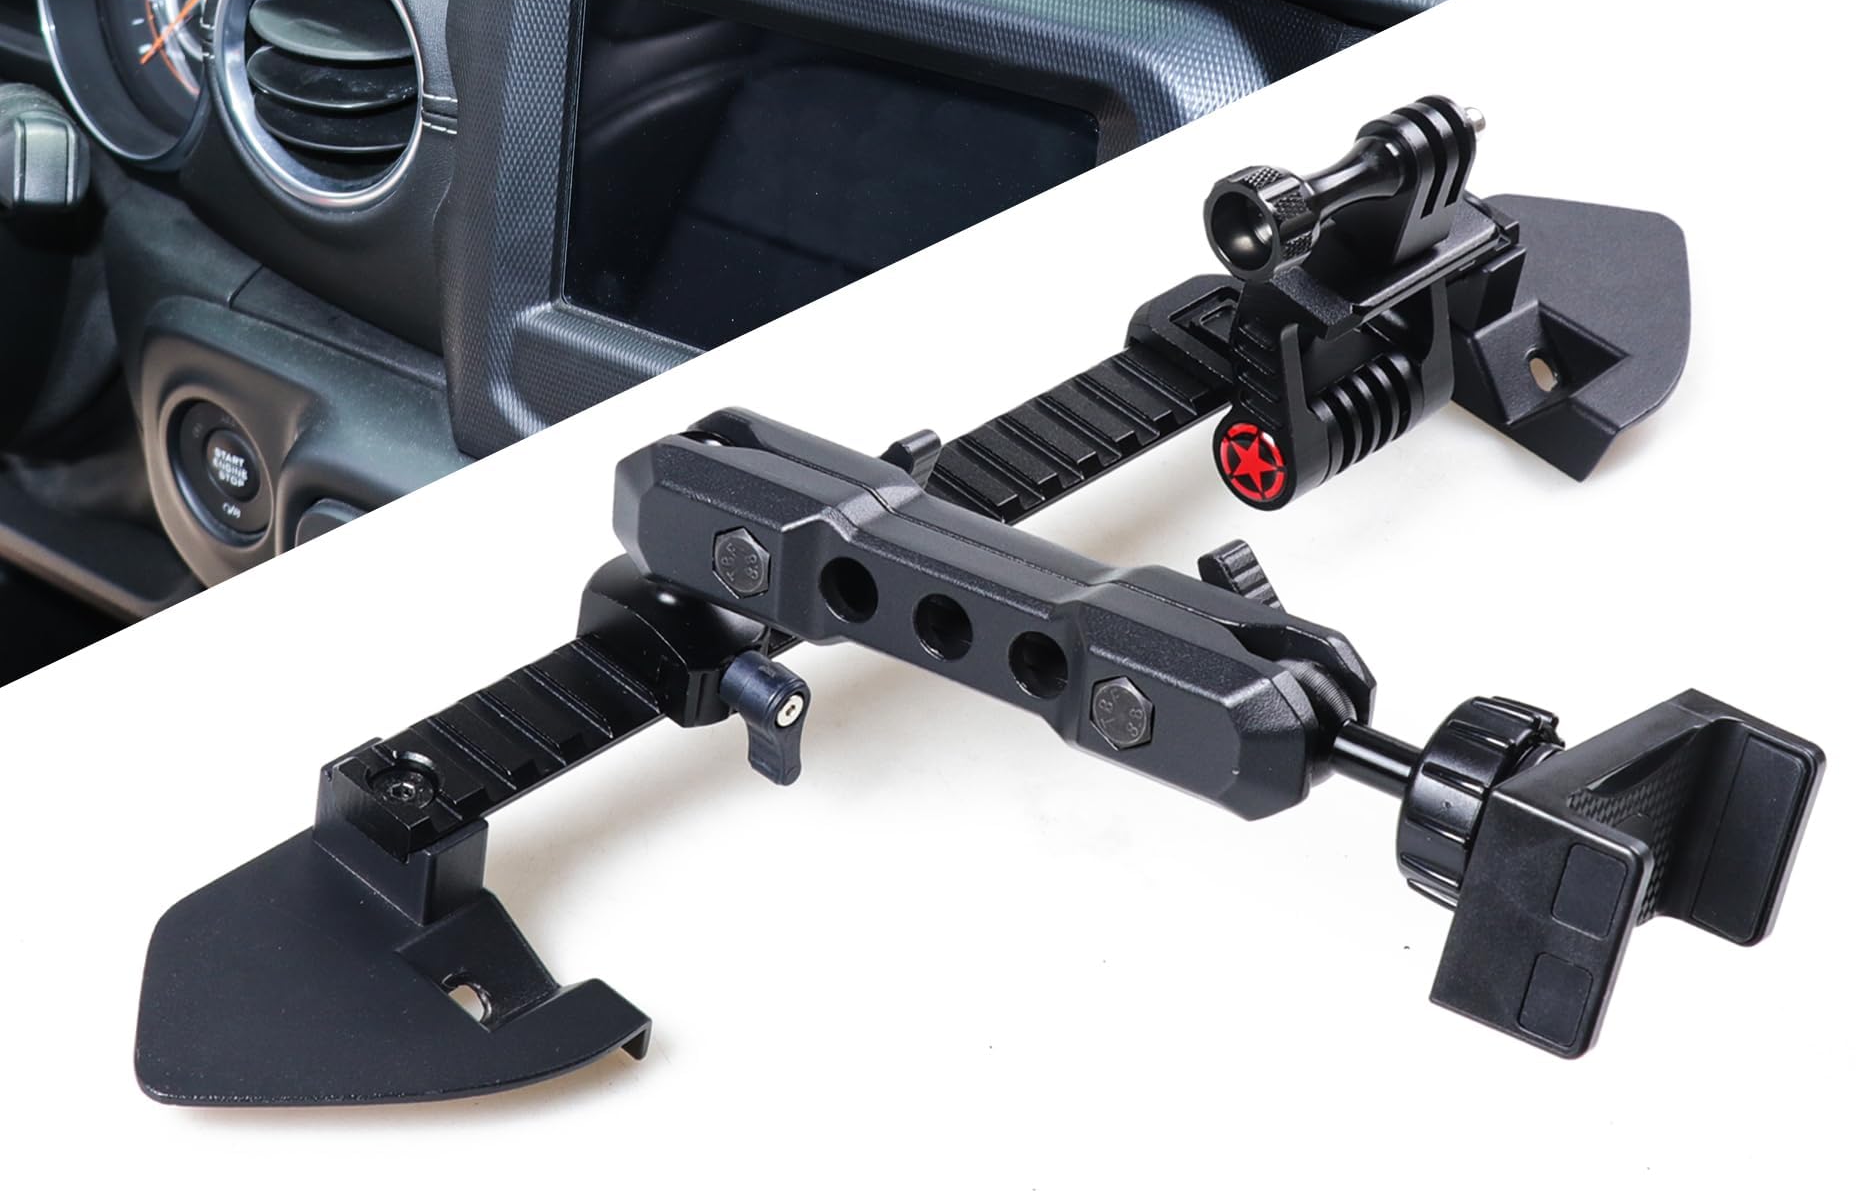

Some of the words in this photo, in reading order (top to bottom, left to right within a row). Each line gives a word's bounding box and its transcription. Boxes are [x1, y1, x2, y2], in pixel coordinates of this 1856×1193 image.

[214, 447, 245, 467] START
[213, 458, 248, 481] ENGINE
[218, 470, 245, 488] STOP
